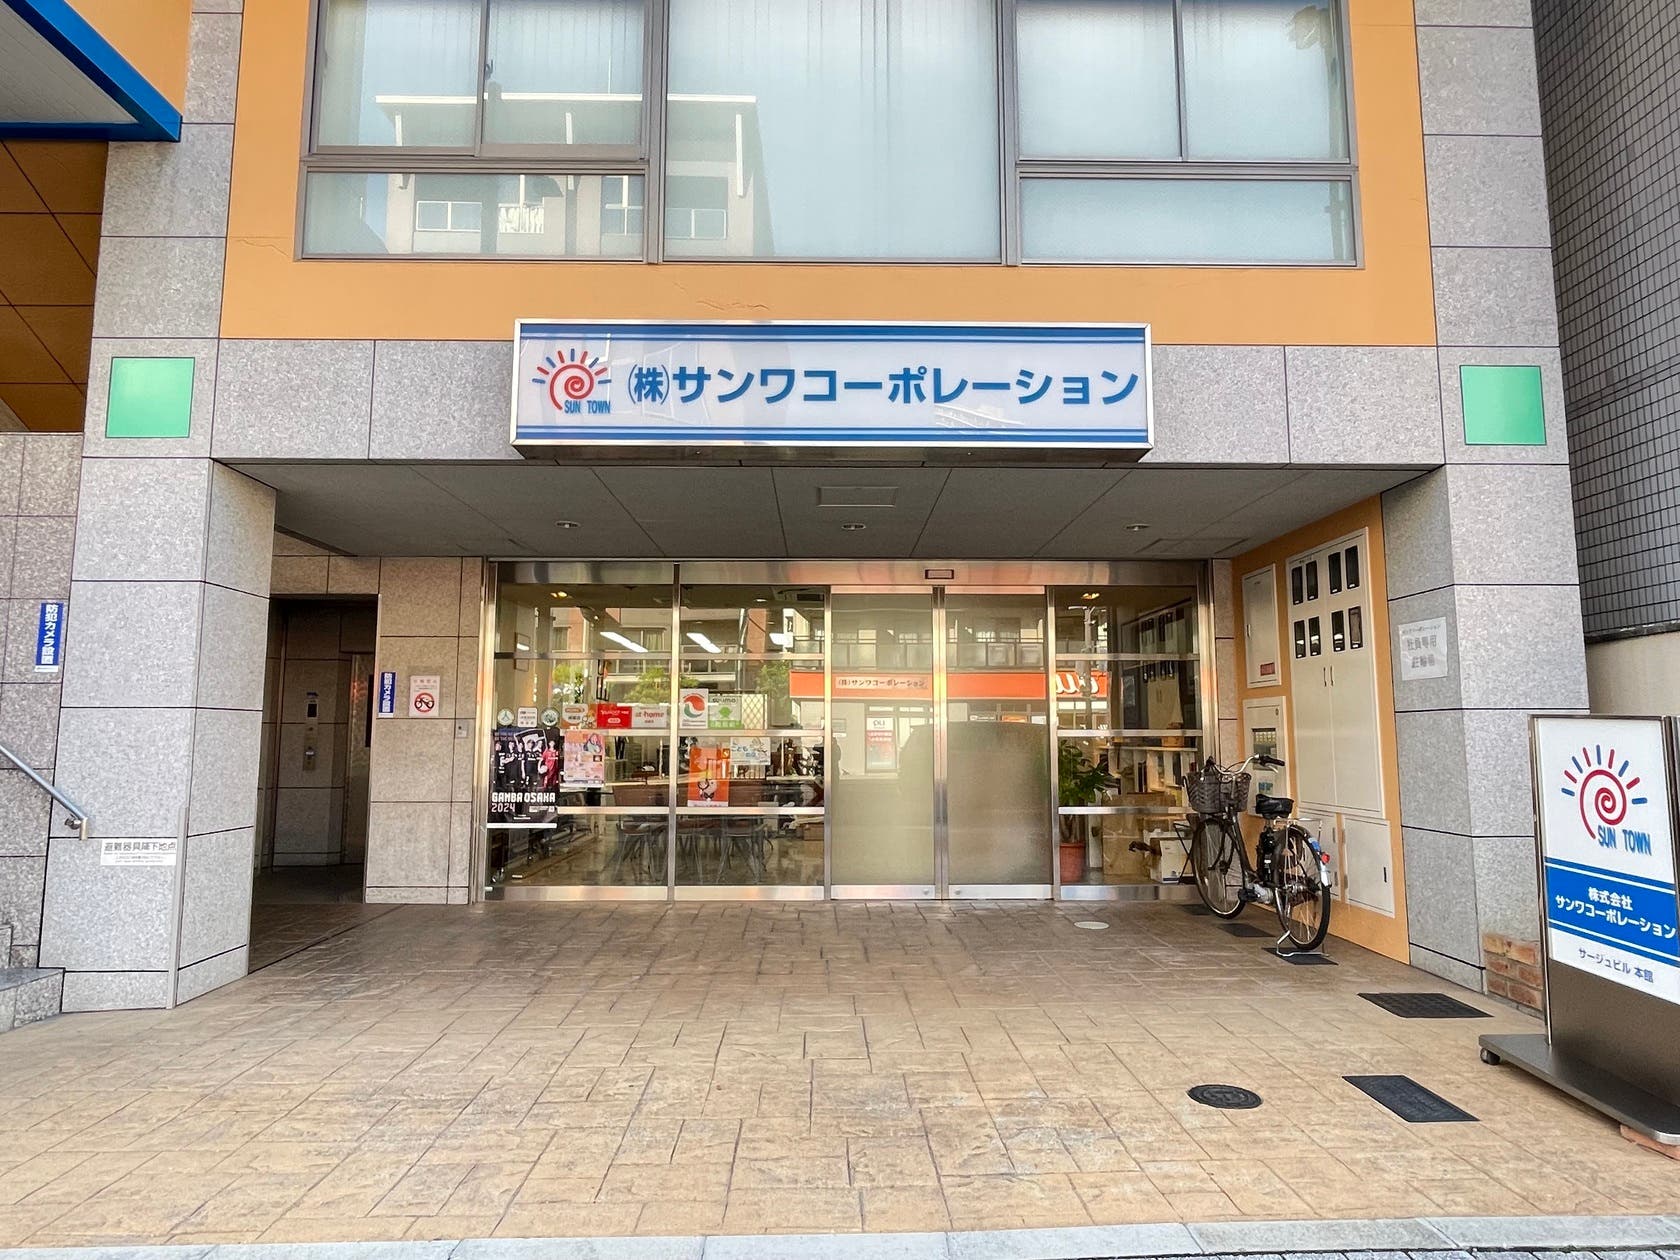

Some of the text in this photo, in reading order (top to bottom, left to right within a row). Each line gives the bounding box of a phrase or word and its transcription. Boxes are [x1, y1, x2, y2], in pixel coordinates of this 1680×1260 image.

[628, 364, 1139, 405] (株)サンワコーポレーション
[564, 401, 611, 415] SUN TOWN
[41, 604, 58, 664] 防犯カメラ設置
[491, 803, 515, 812] 2024
[492, 792, 555, 803] GAMBA OSAKA
[1598, 825, 1652, 856] SUN TOWN
[1588, 887, 1633, 911] 株式会社
[1555, 894, 1676, 939] サンワコーポレーション
[1578, 947, 1654, 983] サージュビル 本館
